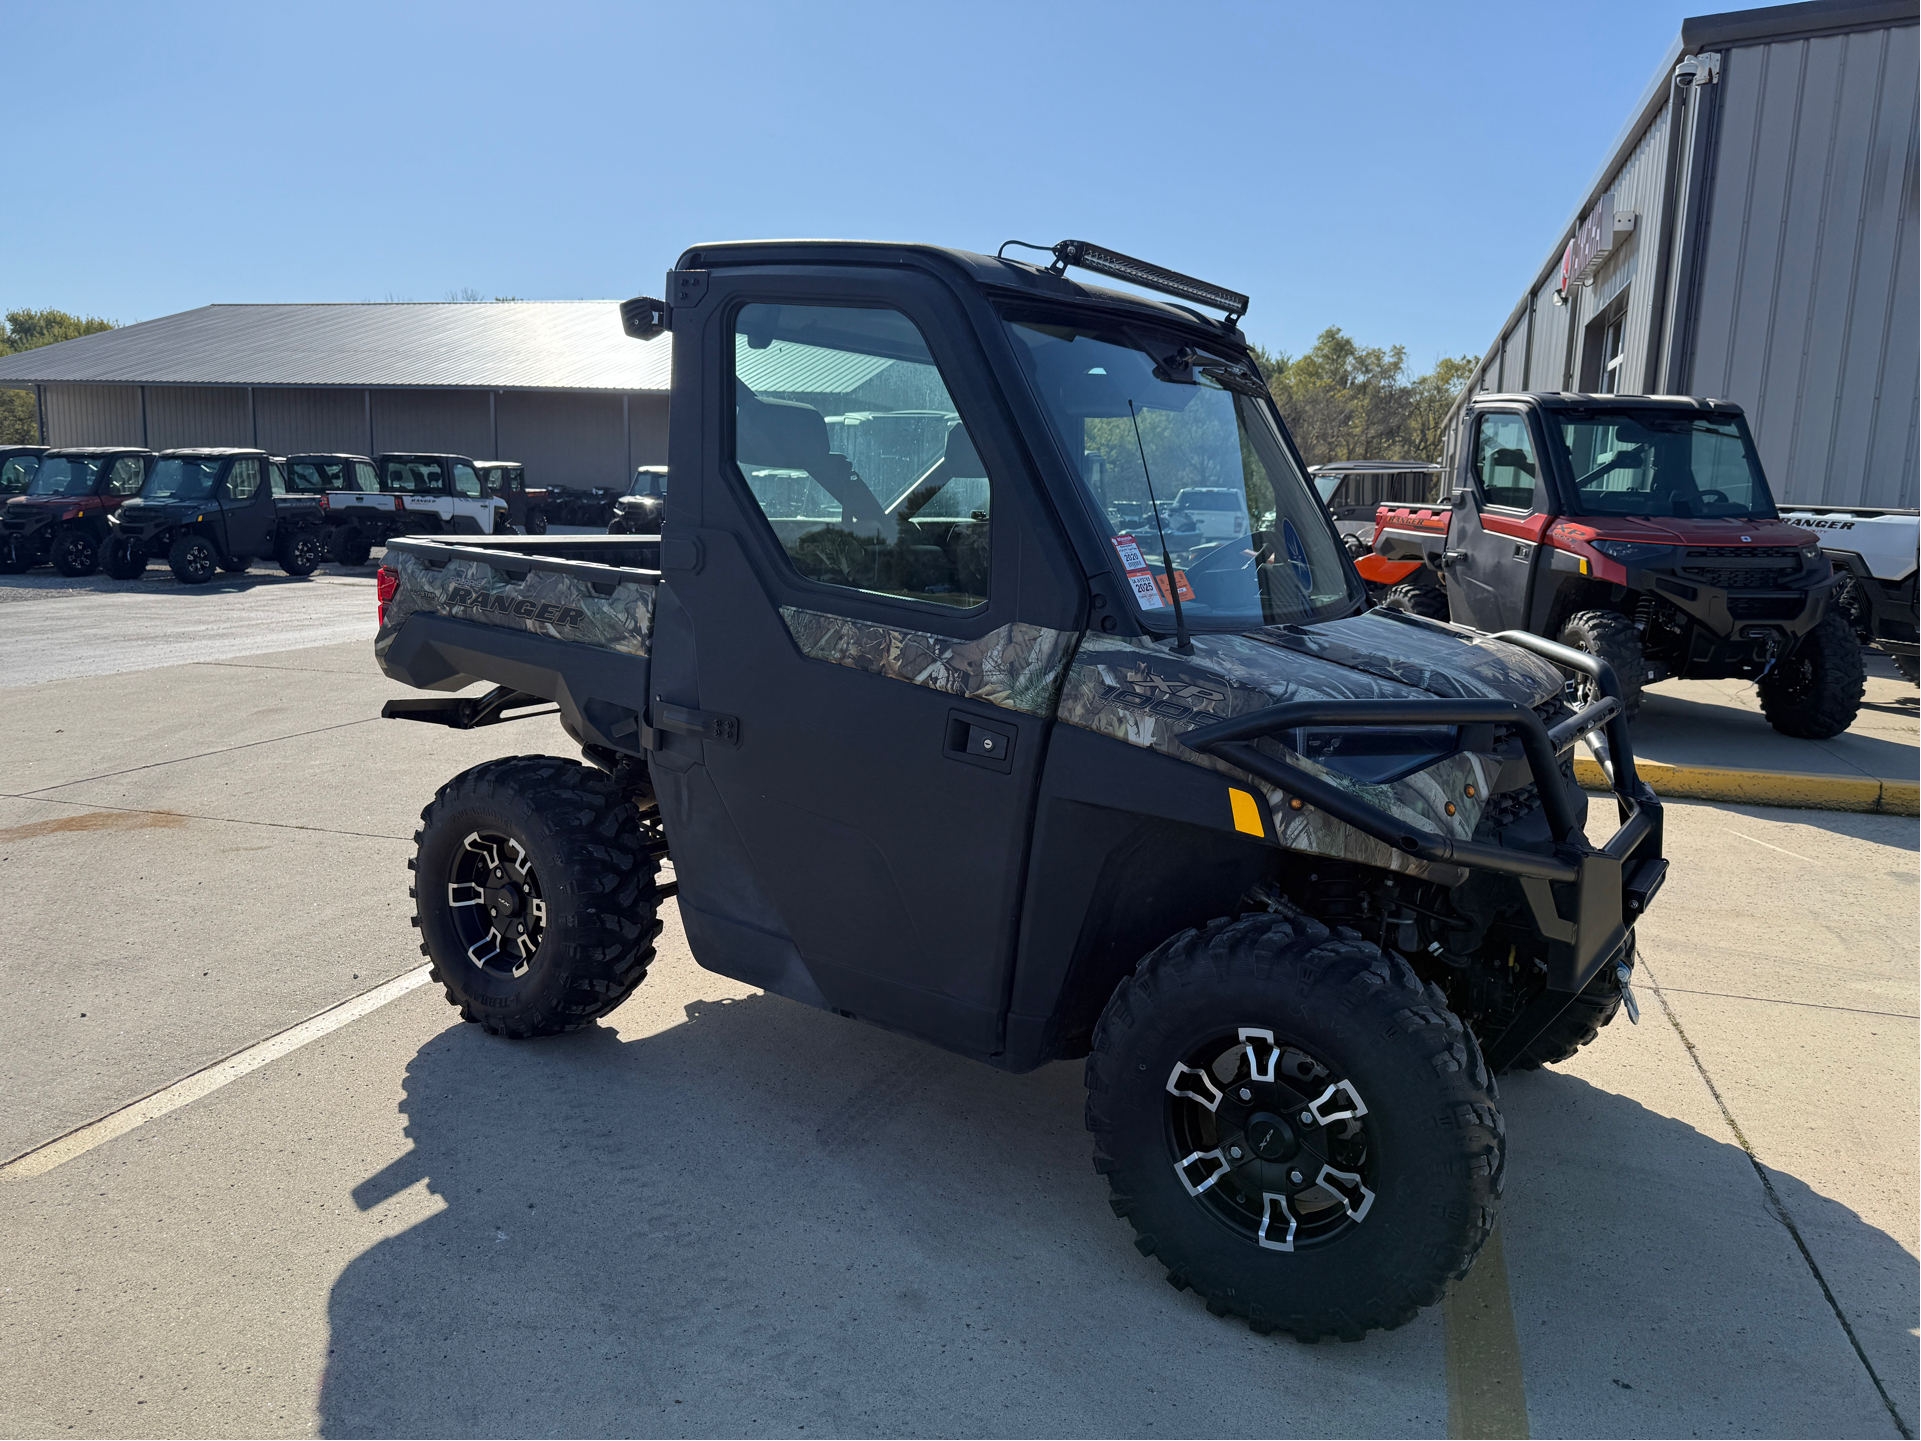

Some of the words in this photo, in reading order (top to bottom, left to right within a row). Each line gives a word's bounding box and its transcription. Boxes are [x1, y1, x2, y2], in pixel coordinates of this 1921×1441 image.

[1388, 516, 1425, 526] RANGER
[1780, 517, 1855, 530] RANGER
[1555, 524, 1586, 536] XP
[450, 576, 483, 588] POLARIS
[1135, 582, 1154, 593] 2025
[446, 585, 585, 628] RANGER
[1127, 672, 1226, 702] XP
[1258, 1128, 1274, 1152] XP
